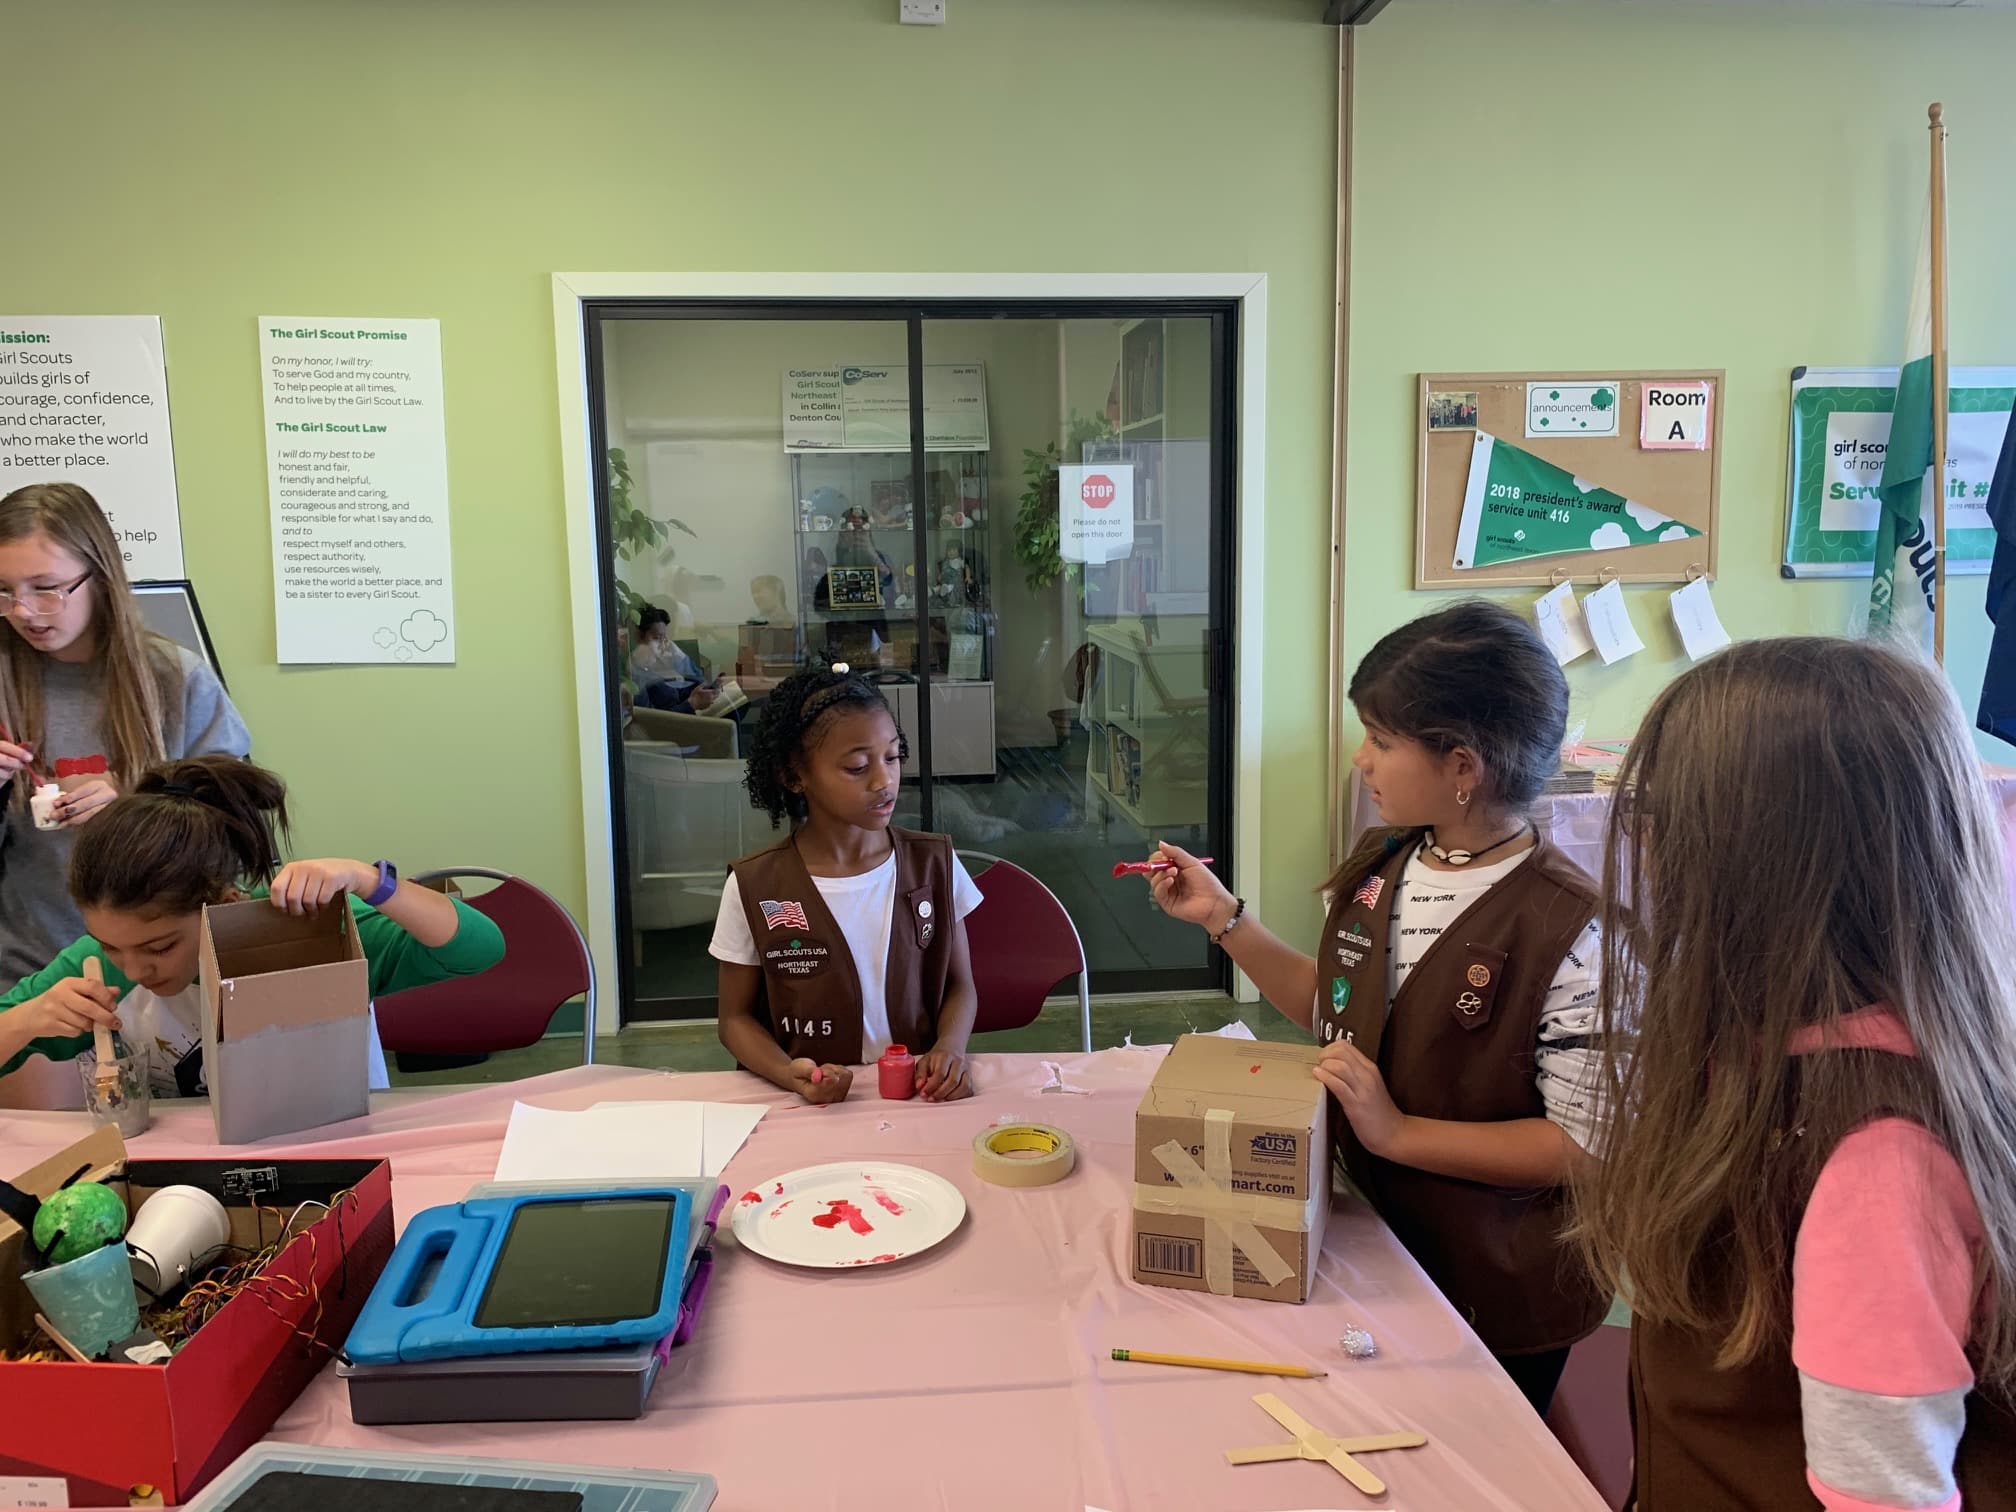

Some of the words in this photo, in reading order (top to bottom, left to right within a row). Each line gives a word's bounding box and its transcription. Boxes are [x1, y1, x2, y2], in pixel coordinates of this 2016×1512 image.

[0, 331, 50, 343] ission:
[270, 329, 293, 338] The
[295, 329, 317, 339] Girl
[320, 330, 355, 339] Scout
[357, 330, 407, 340] Promise
[0, 352, 16, 364] irl
[20, 352, 73, 364] Scouts
[272, 356, 286, 365] On
[287, 358, 303, 367] my
[340, 357, 355, 366] will
[41, 371, 72, 387] girls
[74, 371, 90, 384] of
[272, 369, 285, 378] To
[286, 371, 312, 379] serve
[313, 370, 334, 379] God
[336, 370, 354, 379] and
[355, 371, 370, 381] my
[372, 371, 412, 381] country,
[789, 370, 821, 378] CoServ
[823, 370, 840, 379] sup
[273, 382, 285, 391] To
[287, 382, 307, 393] help
[309, 383, 342, 393] people
[344, 384, 353, 392] at
[355, 384, 366, 392] all
[815, 381, 840, 389] Scout
[64, 391, 154, 406] confidence,
[274, 395, 293, 404] And
[295, 396, 306, 404] to
[307, 396, 323, 405] live
[324, 396, 336, 406] by
[338, 396, 354, 405] the
[355, 396, 372, 405] Girl
[374, 397, 401, 406] Scout
[791, 392, 836, 400] Northeast
[1650, 390, 1706, 406] Room
[811, 402, 837, 411] Collin
[0, 413, 26, 426] and
[30, 412, 106, 426] character,
[276, 422, 299, 432] The
[301, 423, 324, 432] Girl
[326, 423, 361, 433] Scout
[362, 423, 387, 433] Law
[1668, 420, 1685, 440] A
[0, 433, 32, 446] who
[35, 433, 76, 446] make
[79, 433, 104, 445] the
[107, 432, 149, 445] world
[1834, 439, 1858, 456] girl
[282, 449, 297, 458] will
[298, 450, 311, 459] do
[313, 451, 329, 460] my
[329, 450, 350, 459] best
[352, 451, 361, 459] to
[363, 450, 376, 459] be
[3, 456, 11, 466] a
[14, 454, 61, 466] better
[65, 453, 110, 468] place.
[1844, 456, 1858, 470] of
[278, 463, 311, 471] honest
[313, 463, 331, 472] and
[279, 475, 315, 486] friendly
[316, 475, 334, 484] and
[280, 488, 337, 497] considerate
[338, 488, 356, 497] and
[1083, 484, 1113, 498] STOP
[1829, 481, 1881, 500] Serv
[1490, 483, 1520, 499] 2018
[1523, 491, 1584, 509] president's
[1586, 500, 1623, 514] award
[280, 502, 336, 512] courageous
[338, 501, 356, 510] and
[391, 501, 410, 510] and
[1488, 502, 1525, 516] service
[1527, 508, 1548, 520] unit
[1549, 508, 1570, 523] 416
[281, 514, 336, 524] responsible
[338, 514, 351, 522] for
[353, 514, 376, 523] what
[382, 515, 397, 524] say
[400, 515, 417, 523] and
[125, 529, 157, 544] help
[282, 527, 300, 535] and
[302, 527, 312, 535] to
[1091, 530, 1104, 538] this
[283, 540, 319, 550] respect
[321, 540, 352, 550] myself
[354, 540, 372, 548] and
[284, 553, 320, 563] respect
[321, 552, 366, 563] authority,
[284, 566, 301, 574] use
[303, 566, 350, 574] resources
[285, 578, 311, 586] make
[312, 578, 328, 586] the
[330, 578, 356, 586] world
[364, 578, 393, 586] better
[424, 578, 443, 586] and
[286, 590, 298, 598] be
[307, 590, 332, 598] sister
[346, 591, 371, 600] every
[373, 590, 390, 598] Girl
[1433, 894, 1456, 902] YORK
[766, 950, 783, 958] GIRL
[783, 948, 812, 956] SCOUTS
[812, 947, 828, 955] USA
[778, 961, 818, 969] NORTHEAST
[1265, 1138, 1295, 1152] USA
